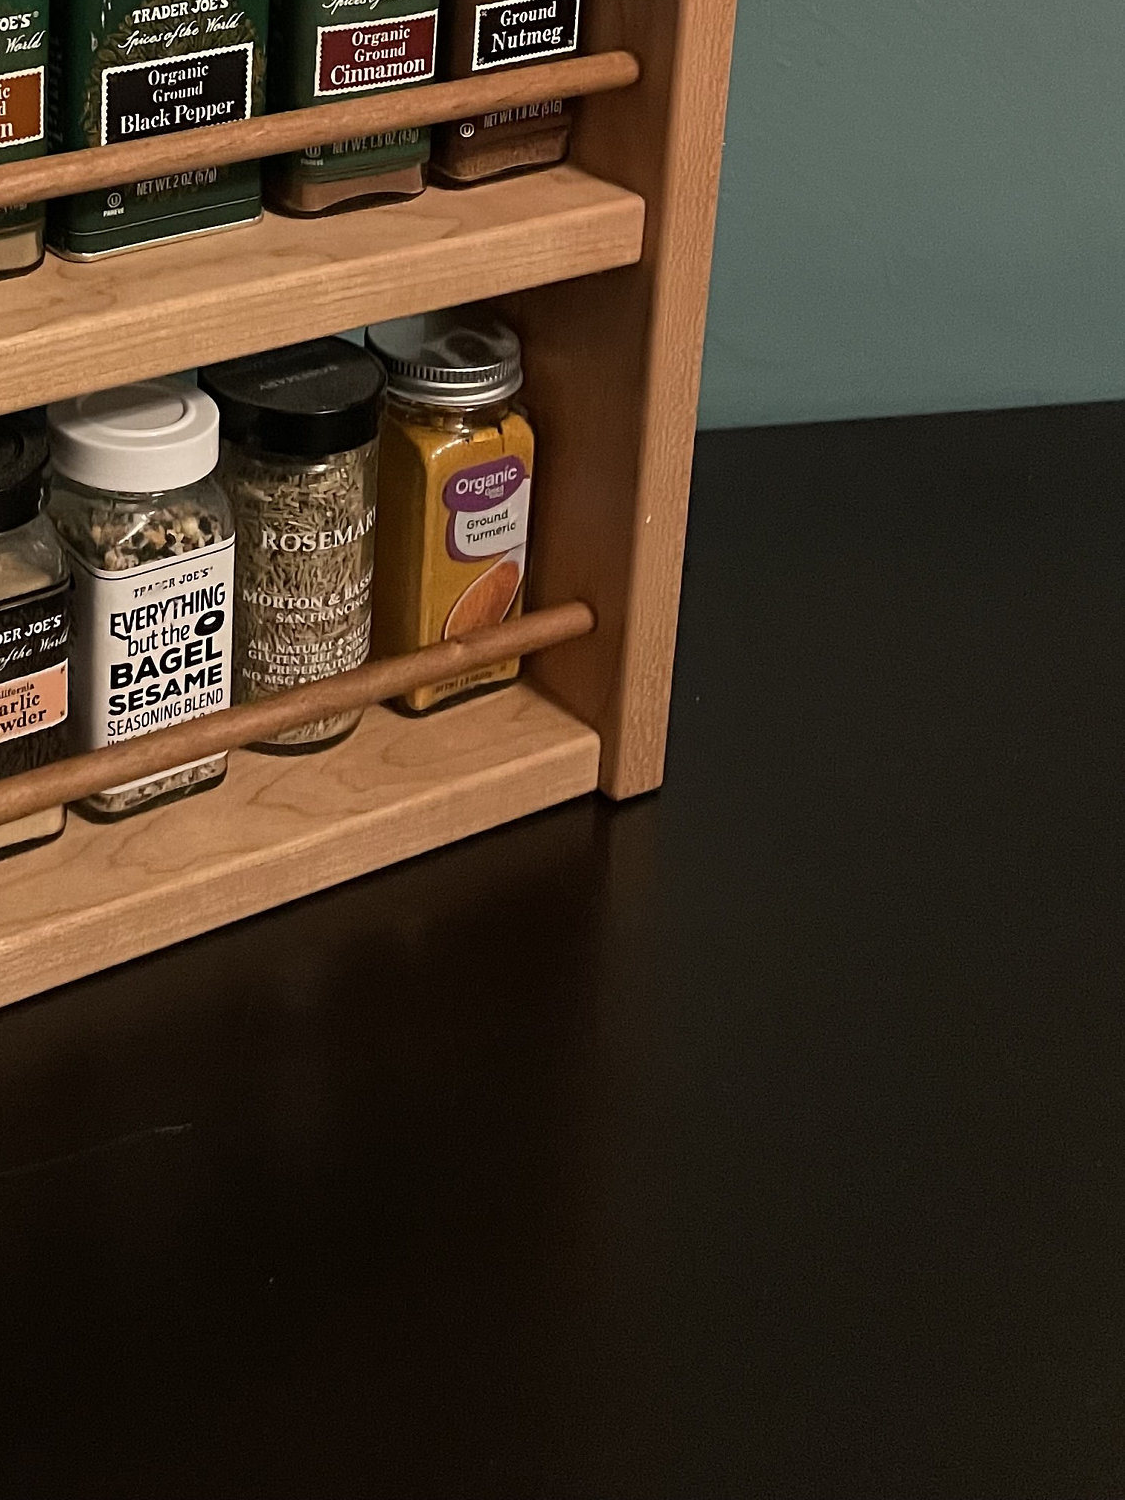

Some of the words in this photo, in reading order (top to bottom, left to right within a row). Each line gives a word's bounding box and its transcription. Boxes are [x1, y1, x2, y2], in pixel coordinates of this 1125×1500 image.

[132, 1, 189, 24] TRADER
[500, 0, 557, 27] Ground
[5, 30, 47, 54] World
[118, 30, 163, 55] Spices
[163, 23, 184, 47] of
[179, 21, 200, 38] the
[205, 12, 245, 33] World
[352, 25, 411, 47] Organic
[491, 26, 564, 53] Nutmeg
[354, 42, 406, 63] Ground
[148, 62, 209, 86] Organic
[330, 58, 425, 85] Cinnamon
[152, 81, 203, 104] Ground
[120, 108, 171, 134] Black
[175, 100, 236, 125] Pepper
[136, 180, 153, 196] NET
[173, 174, 180, 188] 2
[181, 171, 193, 186] OZ
[455, 465, 518, 496] Organic
[466, 508, 509, 530] Ground
[465, 521, 516, 545] Turmeric
[179, 567, 209, 585] JOE'S
[110, 582, 226, 639] EVERYTHING
[242, 588, 324, 609] MORTON
[328, 592, 341, 606] &
[25, 614, 62, 637] JOE'S
[275, 612, 306, 624] SAN
[11, 645, 32, 660] the
[39, 626, 69, 652] World
[127, 628, 159, 657] but
[162, 623, 190, 647] the
[276, 640, 334, 655] NATURAL
[110, 636, 223, 690] BAGEL
[242, 667, 262, 682] NO
[264, 673, 295, 686] MSG
[108, 662, 223, 716] SESAME
[107, 701, 182, 737] SEASONING
[184, 687, 224, 714] BLEND
